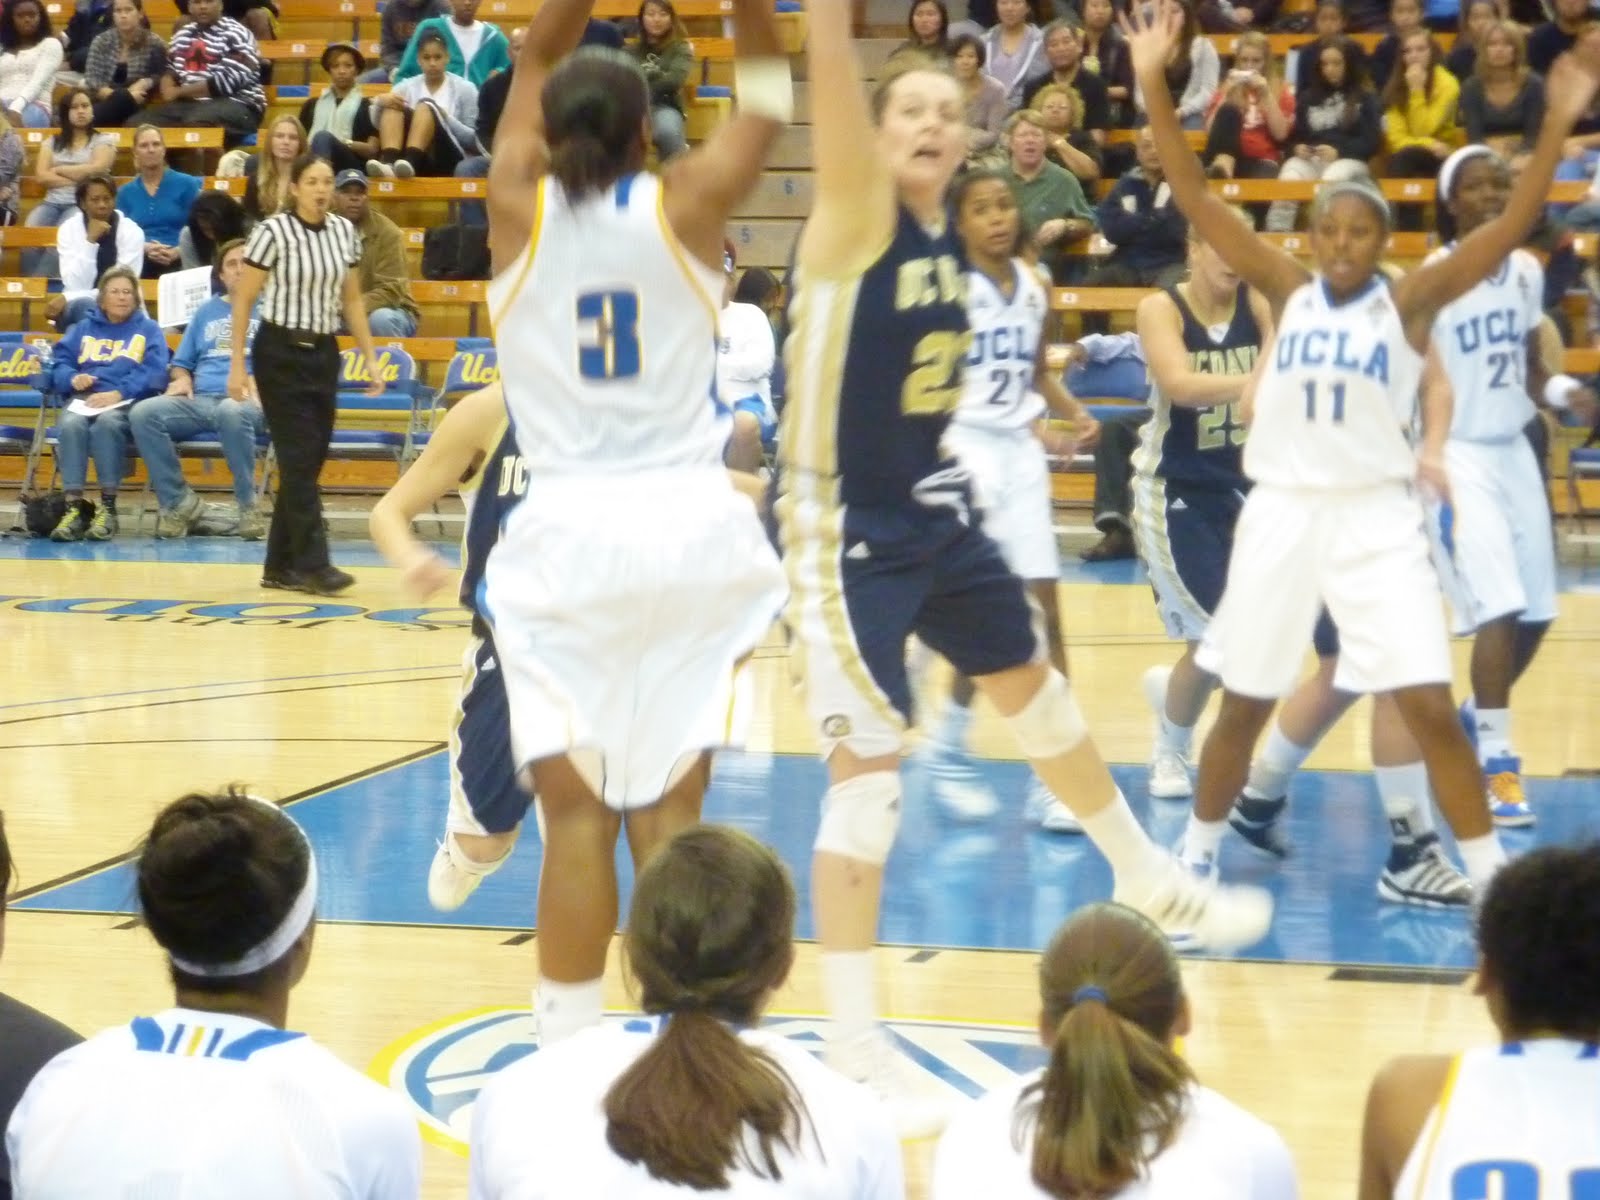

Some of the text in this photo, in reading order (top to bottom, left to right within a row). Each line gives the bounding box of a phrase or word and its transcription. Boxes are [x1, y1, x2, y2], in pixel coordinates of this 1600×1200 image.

[576, 289, 641, 381] 3
[1456, 308, 1520, 354] UCL
[1277, 329, 1389, 386] UCLA
[1303, 379, 1345, 424] 11
